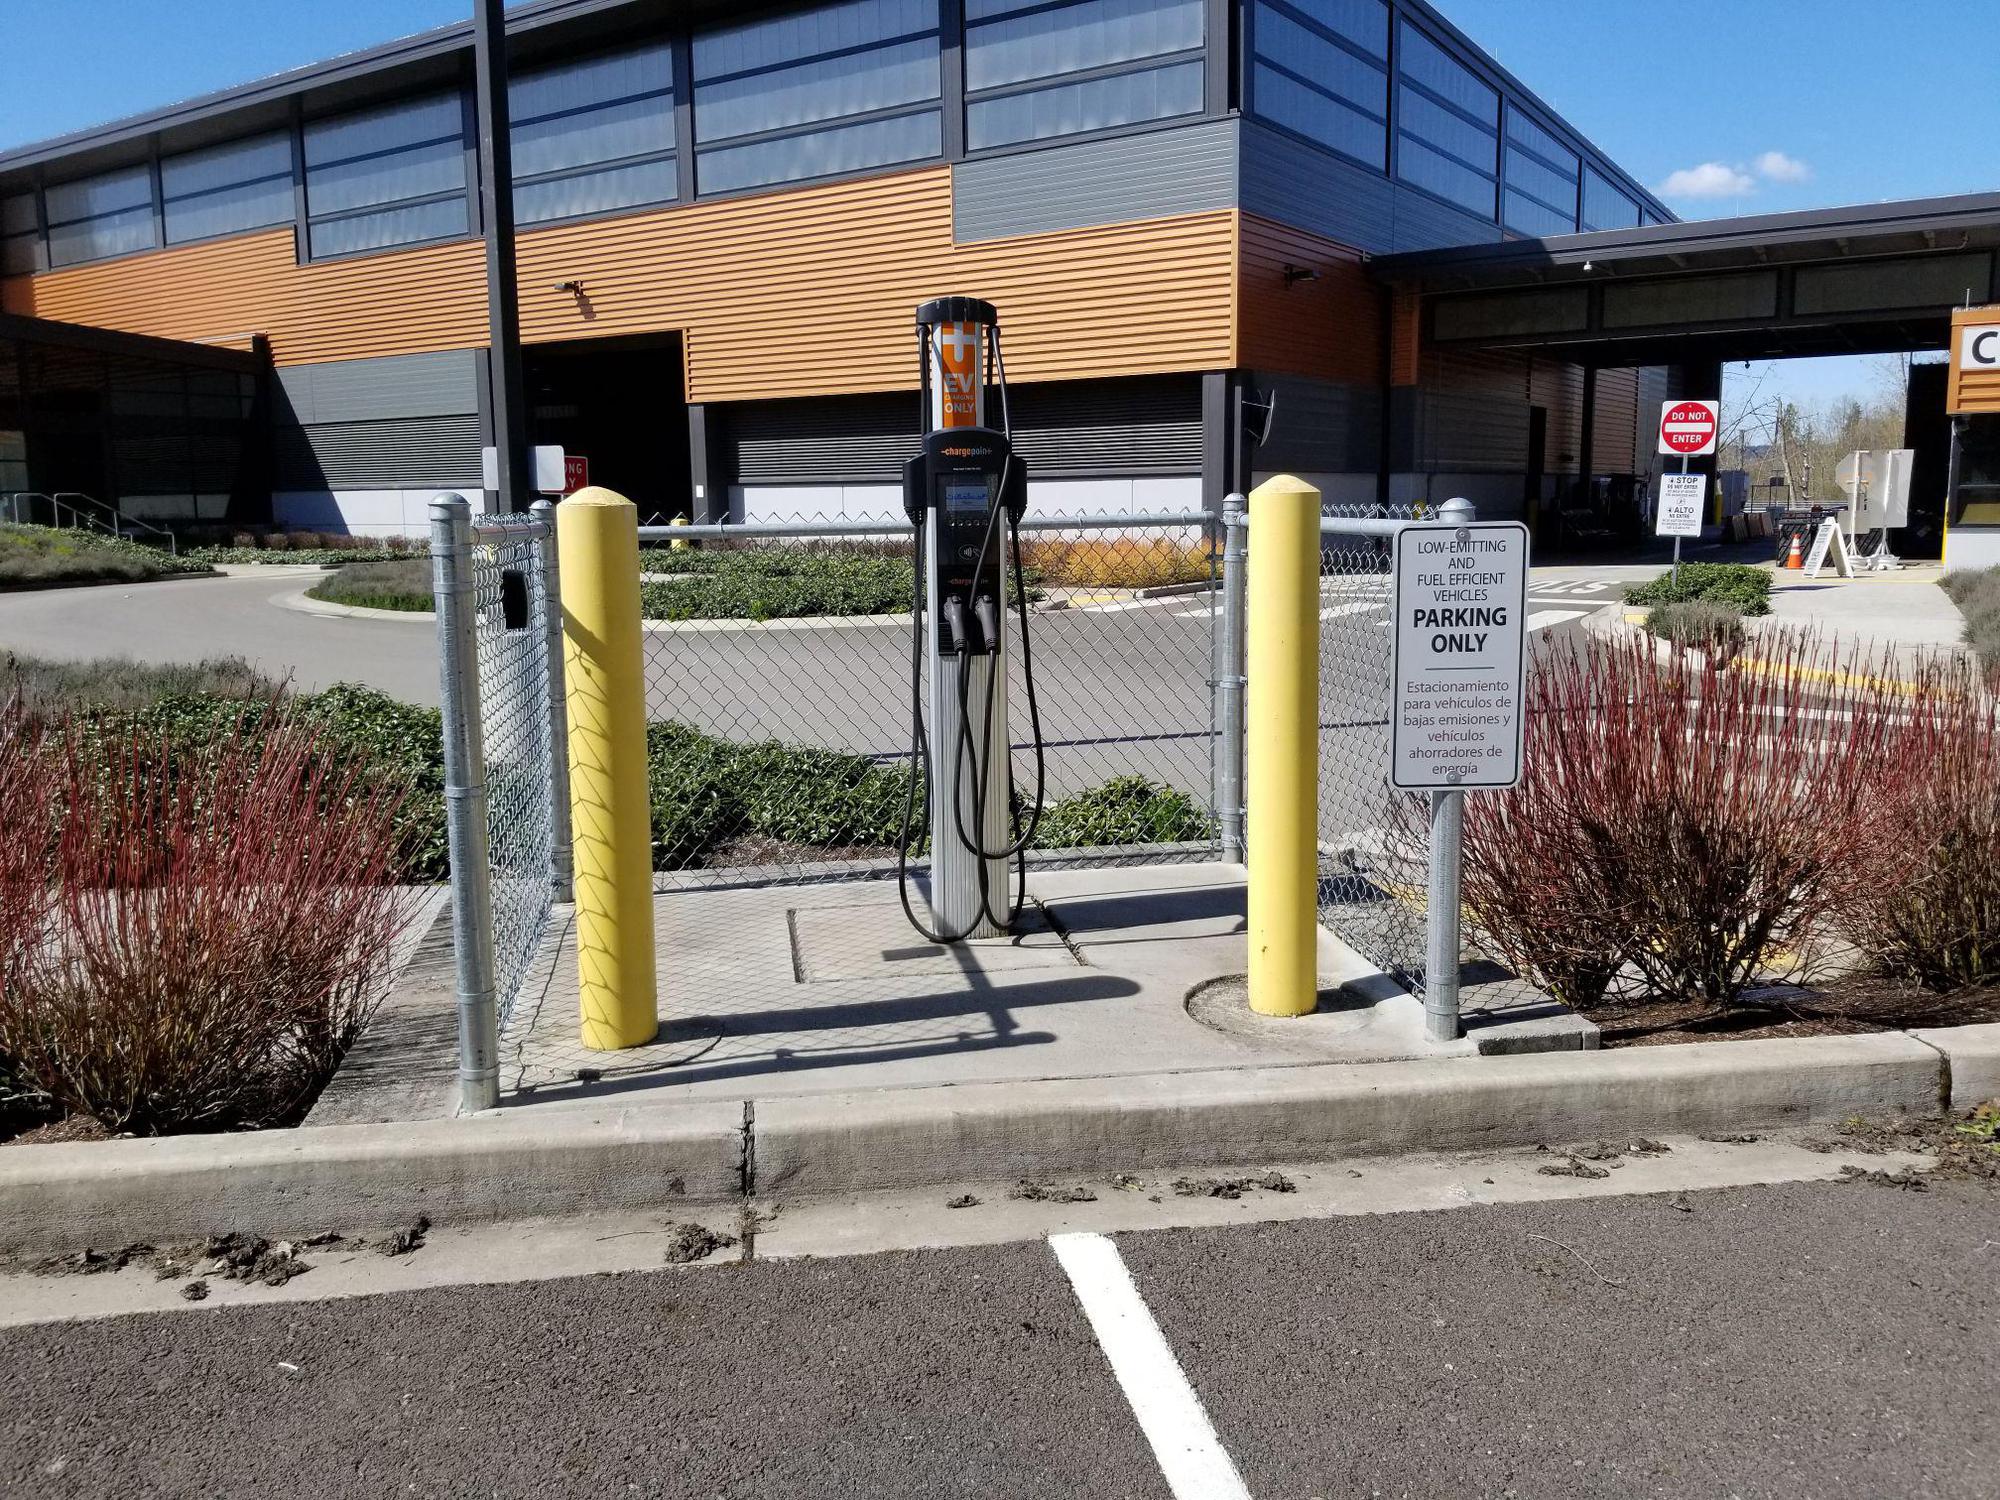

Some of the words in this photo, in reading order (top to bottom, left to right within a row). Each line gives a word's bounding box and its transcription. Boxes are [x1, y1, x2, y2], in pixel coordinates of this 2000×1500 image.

[944, 373, 974, 393] EV
[944, 402, 974, 414] ONLY
[1672, 412, 1685, 421] DO
[1688, 411, 1707, 421] NOT
[1672, 434, 1702, 444] ENTER
[1676, 476, 1698, 484] STOP
[1674, 506, 1695, 514] ALTO
[1418, 540, 1507, 554] LOW-EMITTING
[1448, 557, 1475, 569] AND
[1417, 574, 1446, 586] FUEL
[1449, 572, 1506, 585] EFFICIENT
[1433, 589, 1488, 602] VEHICLES
[1413, 607, 1507, 628] PARKING
[1431, 633, 1488, 653] ONLY
[1407, 680, 1509, 693] Estacionamiento
[1404, 700, 1431, 713] para
[1434, 696, 1492, 709] vehículos
[1495, 695, 1512, 708] de
[1403, 714, 1435, 729] bajas
[1438, 713, 1500, 725] emisiones
[1503, 715, 1511, 727] y
[1428, 729, 1485, 742] vehículos
[1409, 746, 1483, 759] ahorradores
[1486, 744, 1503, 757] de
[1432, 762, 1478, 777] energía
